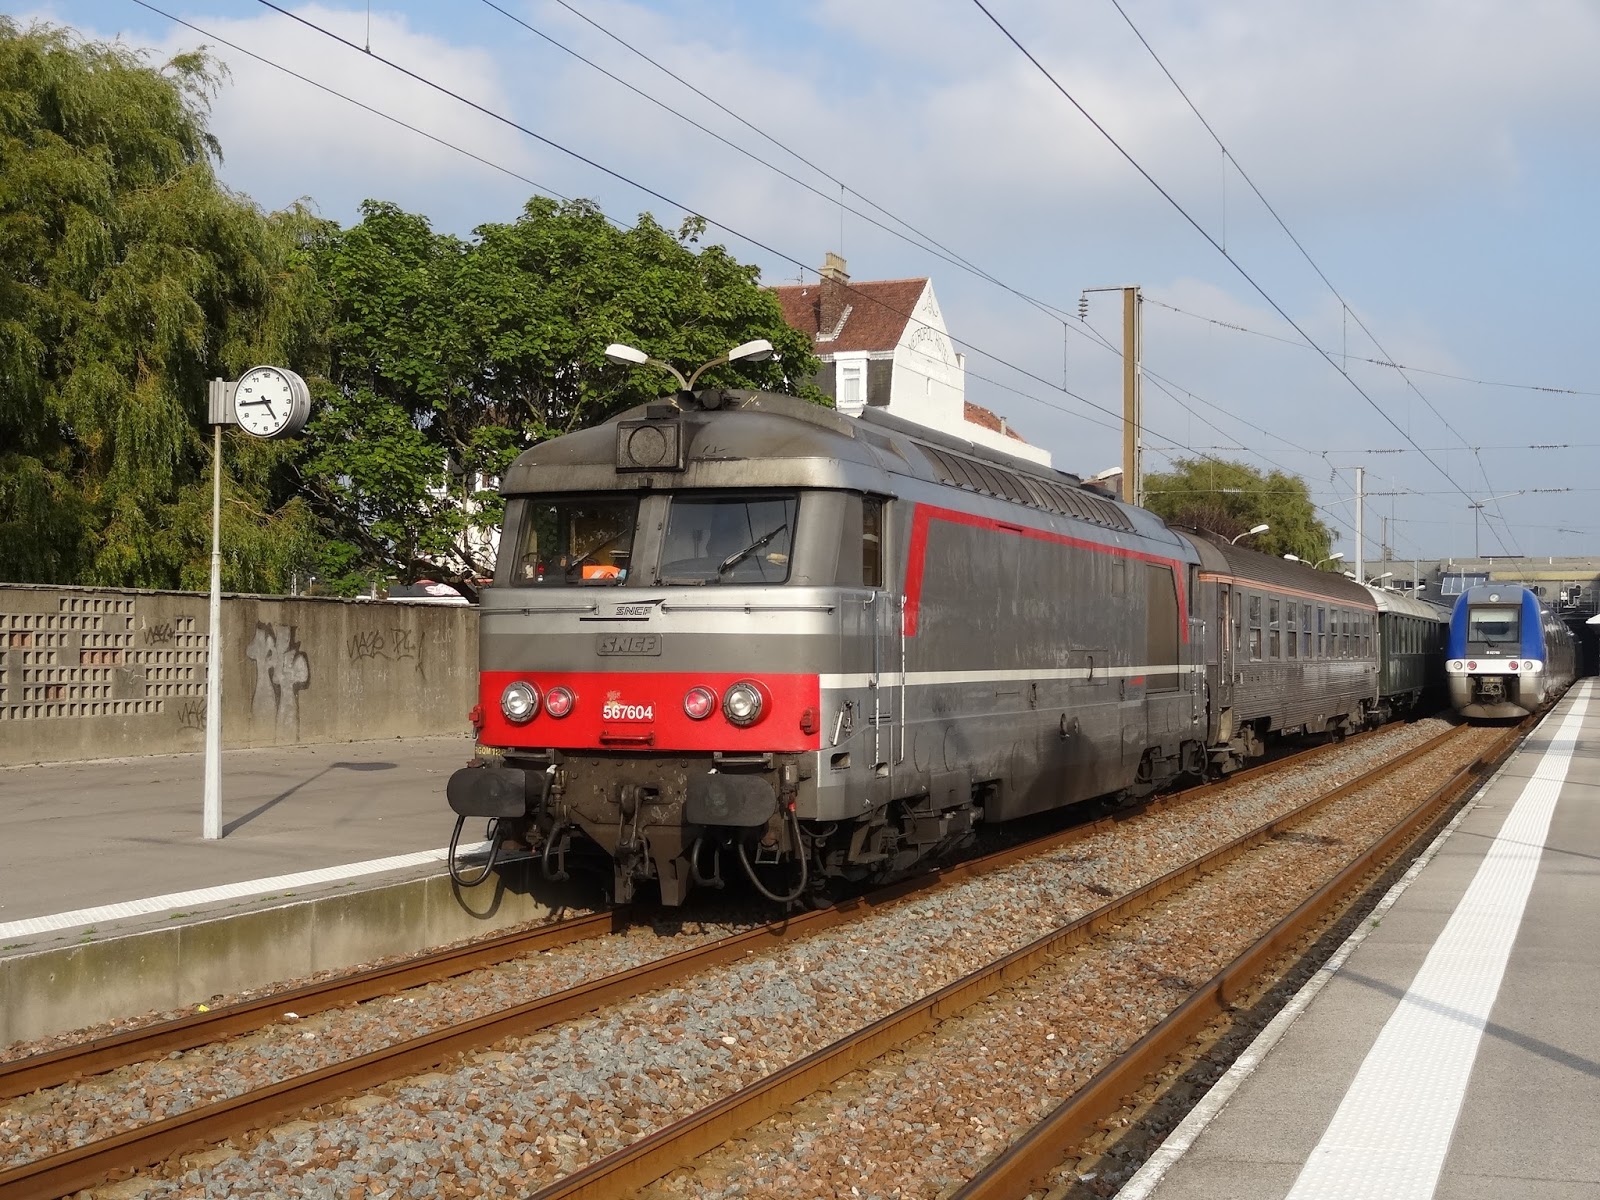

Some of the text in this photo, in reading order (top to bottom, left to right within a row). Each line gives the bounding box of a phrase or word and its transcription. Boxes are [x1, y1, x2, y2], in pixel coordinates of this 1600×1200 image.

[615, 606, 653, 616] SNCF
[600, 637, 657, 653] SNCF
[602, 705, 654, 720] 567604
